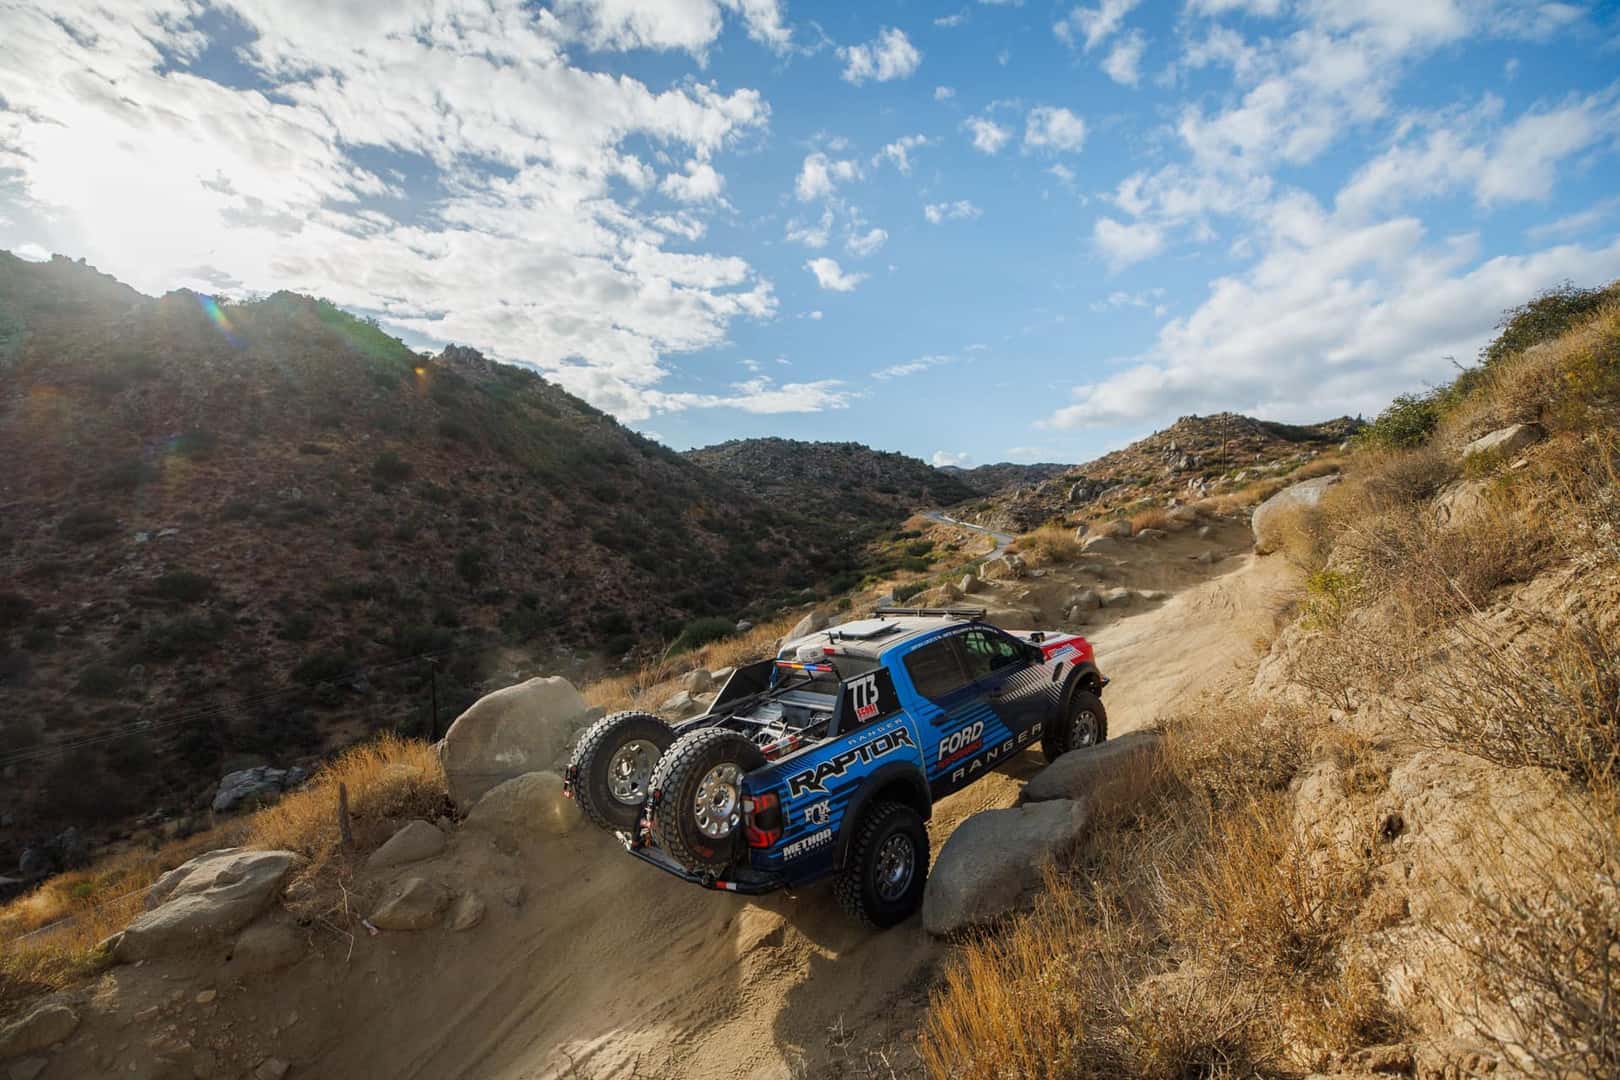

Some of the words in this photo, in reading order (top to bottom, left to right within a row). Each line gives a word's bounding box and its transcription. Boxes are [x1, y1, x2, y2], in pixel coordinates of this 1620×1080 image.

[847, 673, 879, 712] 773
[938, 720, 984, 761] FORD
[952, 722, 1042, 783] RANGER
[787, 726, 917, 799] RAPTOR
[804, 800, 831, 825] FOX
[783, 828, 832, 857] METHOD
